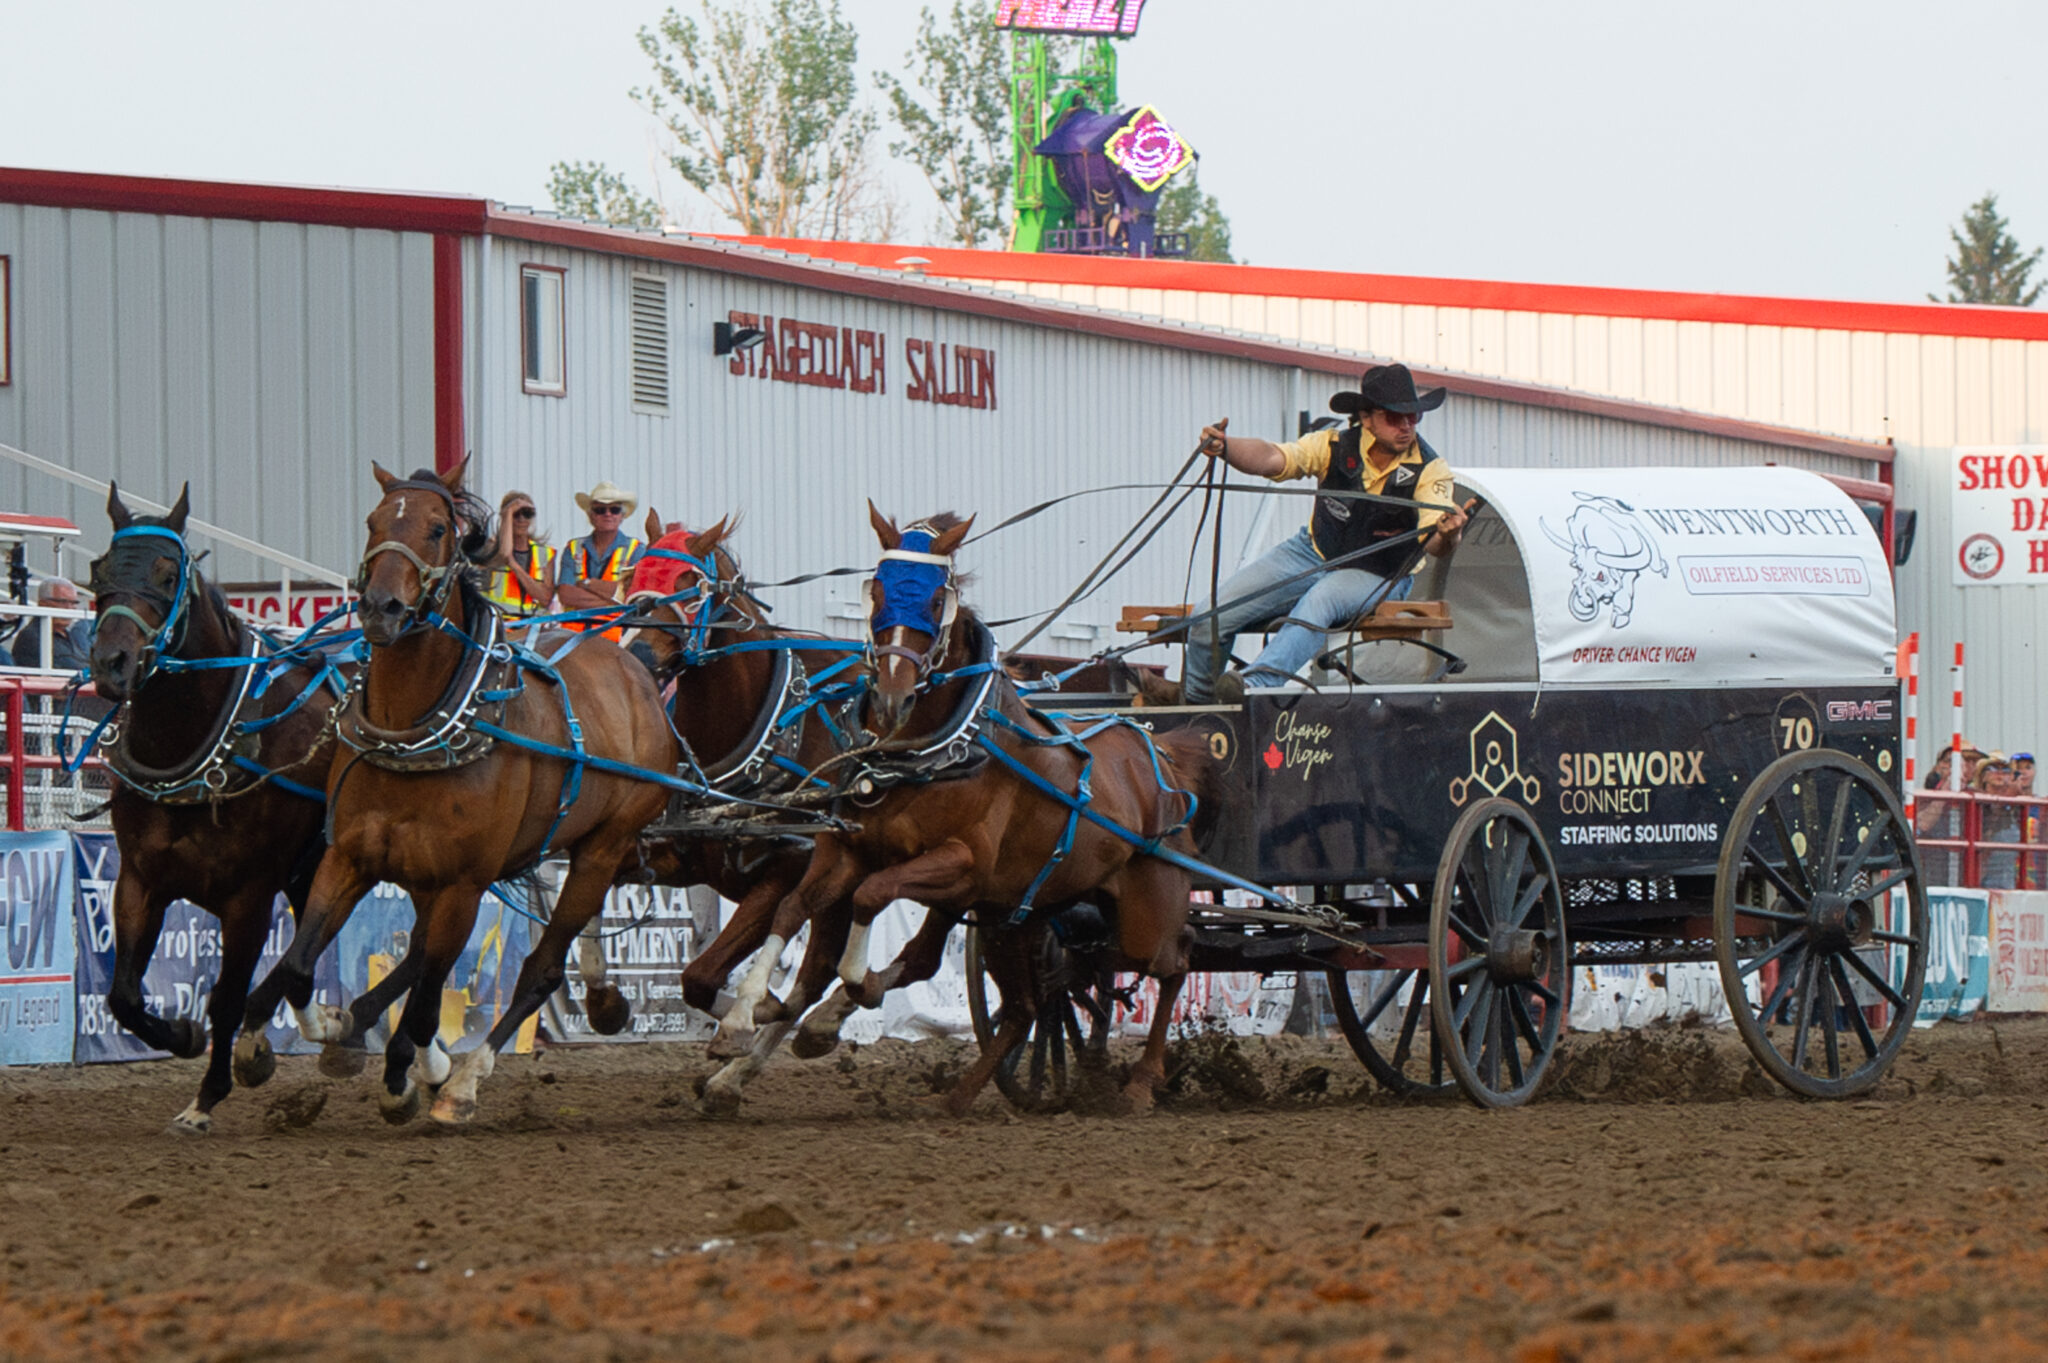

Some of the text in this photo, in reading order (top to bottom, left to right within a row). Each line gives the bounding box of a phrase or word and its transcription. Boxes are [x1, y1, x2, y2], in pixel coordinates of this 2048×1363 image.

[906, 338, 997, 411] SALOON
[1643, 508, 1859, 536] WENTWORTH
[1690, 566, 1862, 585] OILFIELD SERVICES LTD
[1618, 646, 1661, 663] CHANCE
[1663, 646, 1697, 663] VIGEN
[1826, 699, 1892, 721] GMC
[1200, 732, 1229, 761] 0
[1780, 717, 1813, 750] 70
[1286, 738, 1334, 782] Vigen
[1558, 750, 1706, 787] SIDEWORX
[1559, 788, 1651, 815] CONNECT
[1560, 823, 1718, 846] STAFFING SOLUTIONS
[16, 991, 60, 1032] Legend
